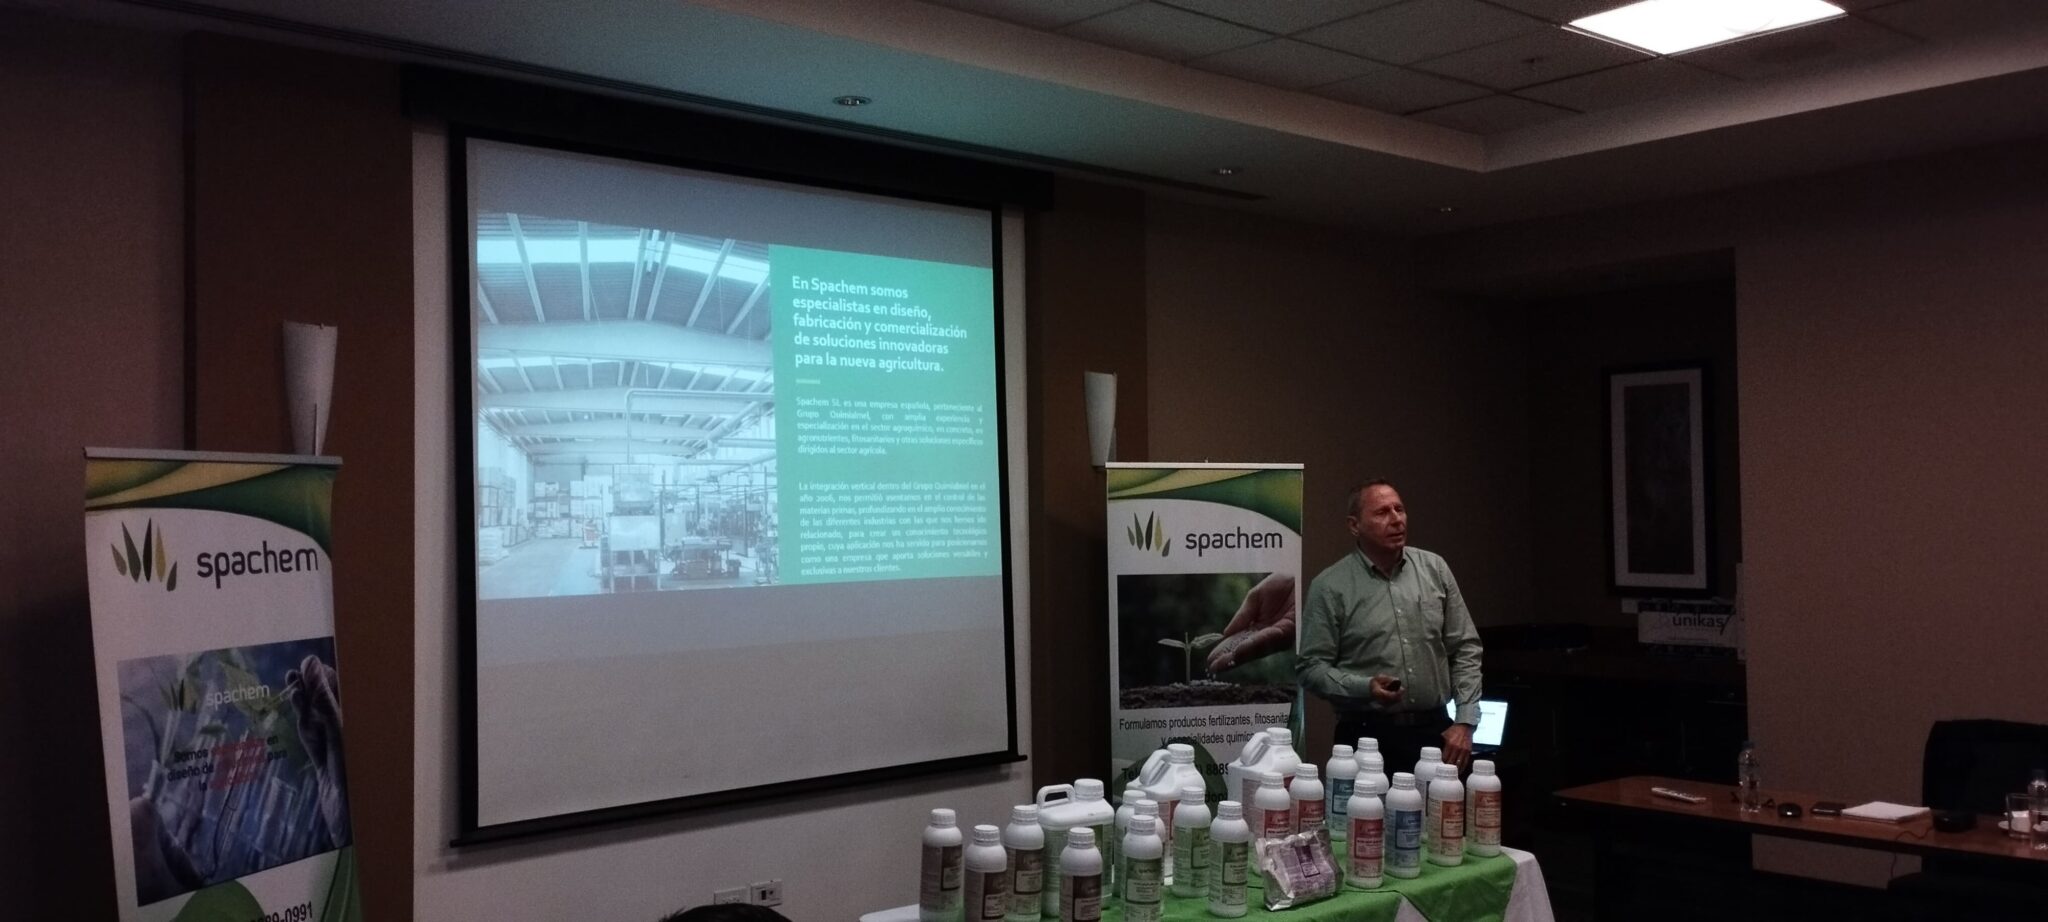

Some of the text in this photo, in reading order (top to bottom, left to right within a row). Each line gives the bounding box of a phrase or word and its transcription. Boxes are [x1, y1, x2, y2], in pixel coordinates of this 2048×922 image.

[792, 276, 908, 299] En Spachem somos
[793, 297, 932, 321] especialistas en diseño,
[793, 313, 967, 339] fabricación y comercialización
[794, 332, 949, 354] de soluciones innovadoras
[795, 352, 944, 373] para la nueva agricultura.
[796, 397, 829, 407] Spachem
[809, 481, 849, 492] integración
[851, 481, 875, 490] vertical
[1185, 526, 1283, 557] spachem
[197, 541, 319, 589] spachem
[206, 684, 270, 711] spachem
[1119, 718, 1167, 730] Formulamos
[1169, 716, 1206, 730] productos
[1208, 714, 1253, 728] fertilizantes,
[267, 735, 279, 746] en
[202, 762, 214, 774] de
[267, 750, 288, 763] para
